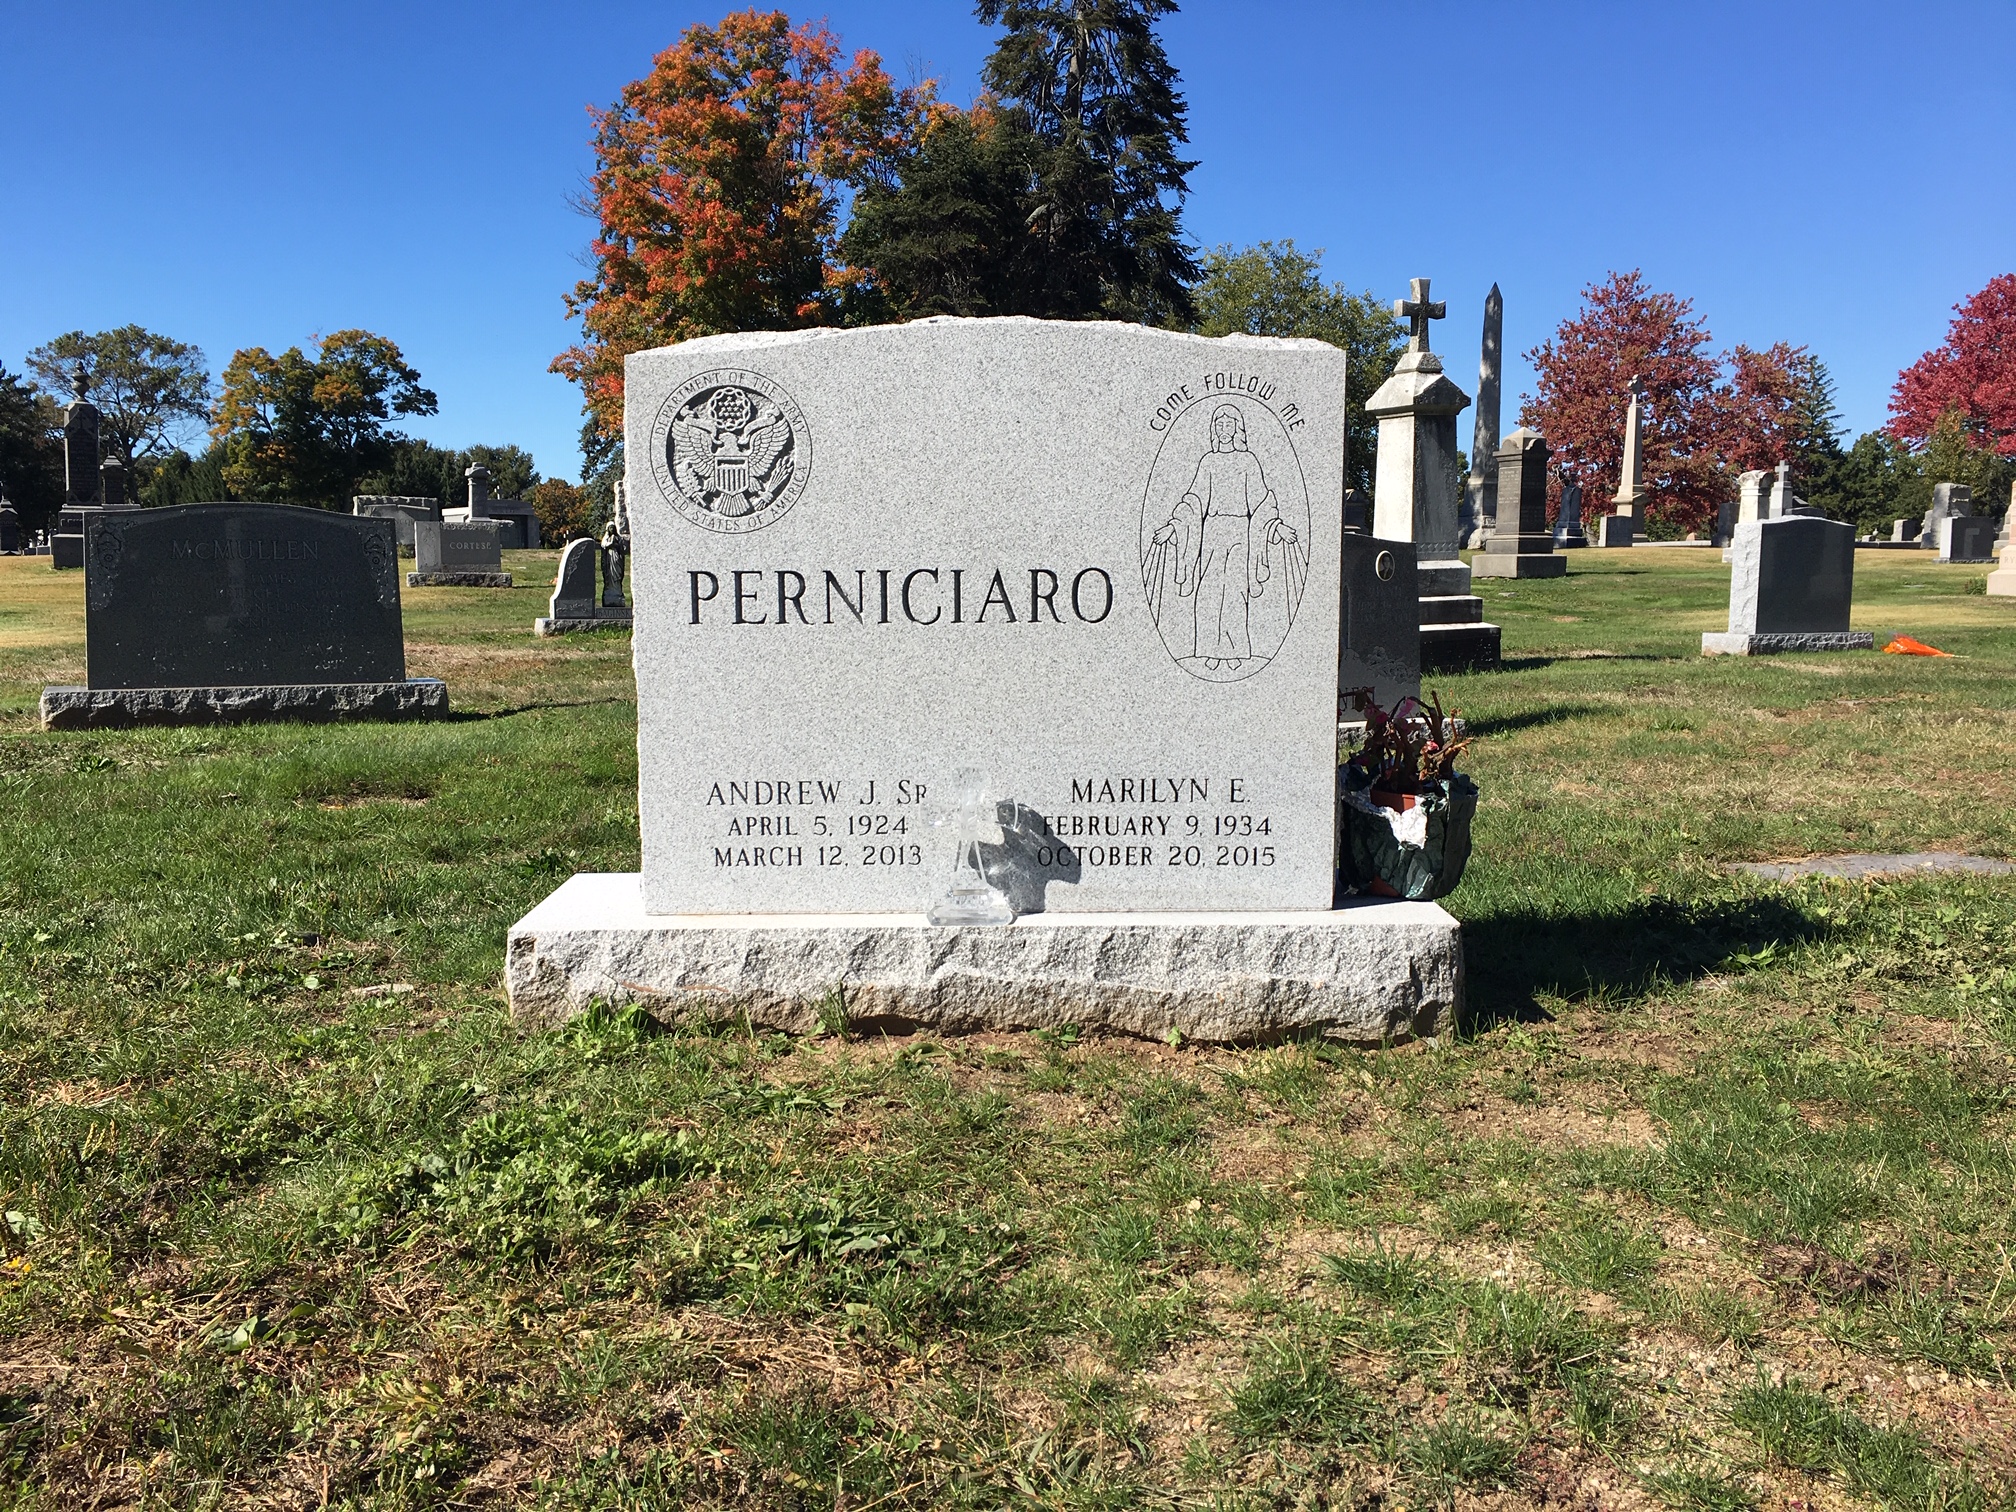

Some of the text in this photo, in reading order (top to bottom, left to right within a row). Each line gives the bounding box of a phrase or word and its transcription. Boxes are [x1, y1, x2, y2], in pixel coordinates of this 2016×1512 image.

[655, 371, 807, 436] DEPARTMENT OF THE ARMY
[1150, 372, 1306, 432] COME FOLLOW ME
[655, 464, 808, 531] UNITED STATES OF AMERICA
[686, 567, 1115, 626] PERNICIARO
[705, 780, 842, 806] ANDREW
[859, 780, 882, 805] J.
[1071, 778, 1251, 804] MARILYN E.
[727, 816, 799, 836] APRIL
[848, 814, 909, 836] 1924
[1042, 815, 1172, 836] FEBRUARY
[1214, 815, 1273, 837] 1934
[714, 846, 802, 867] MARCH
[862, 844, 922, 866] 2013
[1036, 845, 1153, 867] OCTOBER
[1216, 845, 1276, 867] 2015
